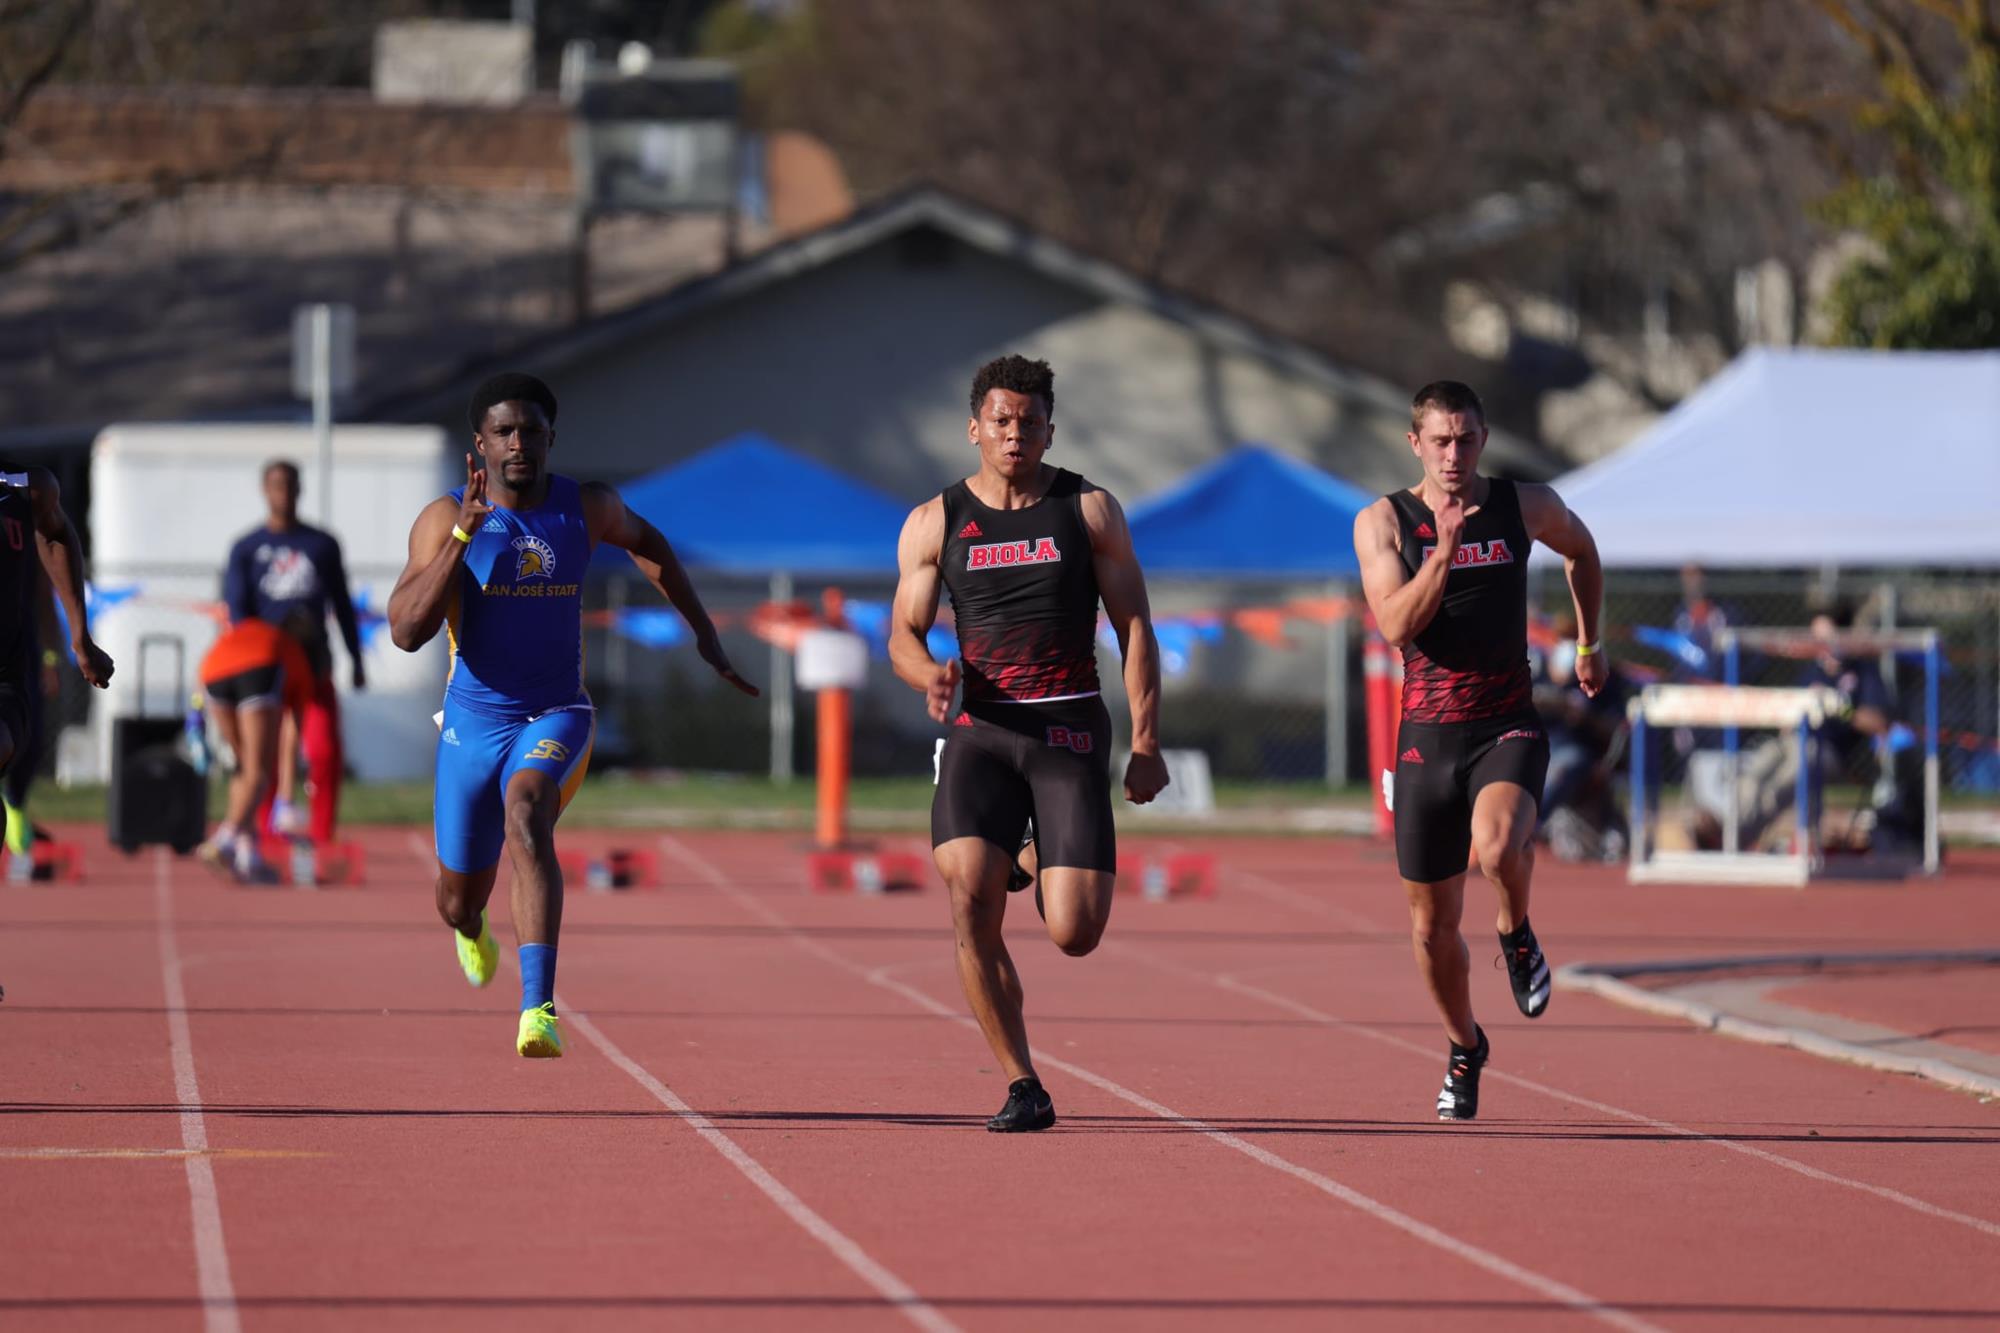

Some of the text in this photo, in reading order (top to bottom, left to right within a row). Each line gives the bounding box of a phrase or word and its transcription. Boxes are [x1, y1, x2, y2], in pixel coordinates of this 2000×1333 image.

[967, 537, 1061, 571] BIOLA
[1422, 539, 1513, 569] OLA
[482, 582, 578, 597] SAN JOSÉ STATE
[1047, 726, 1093, 754] BU
